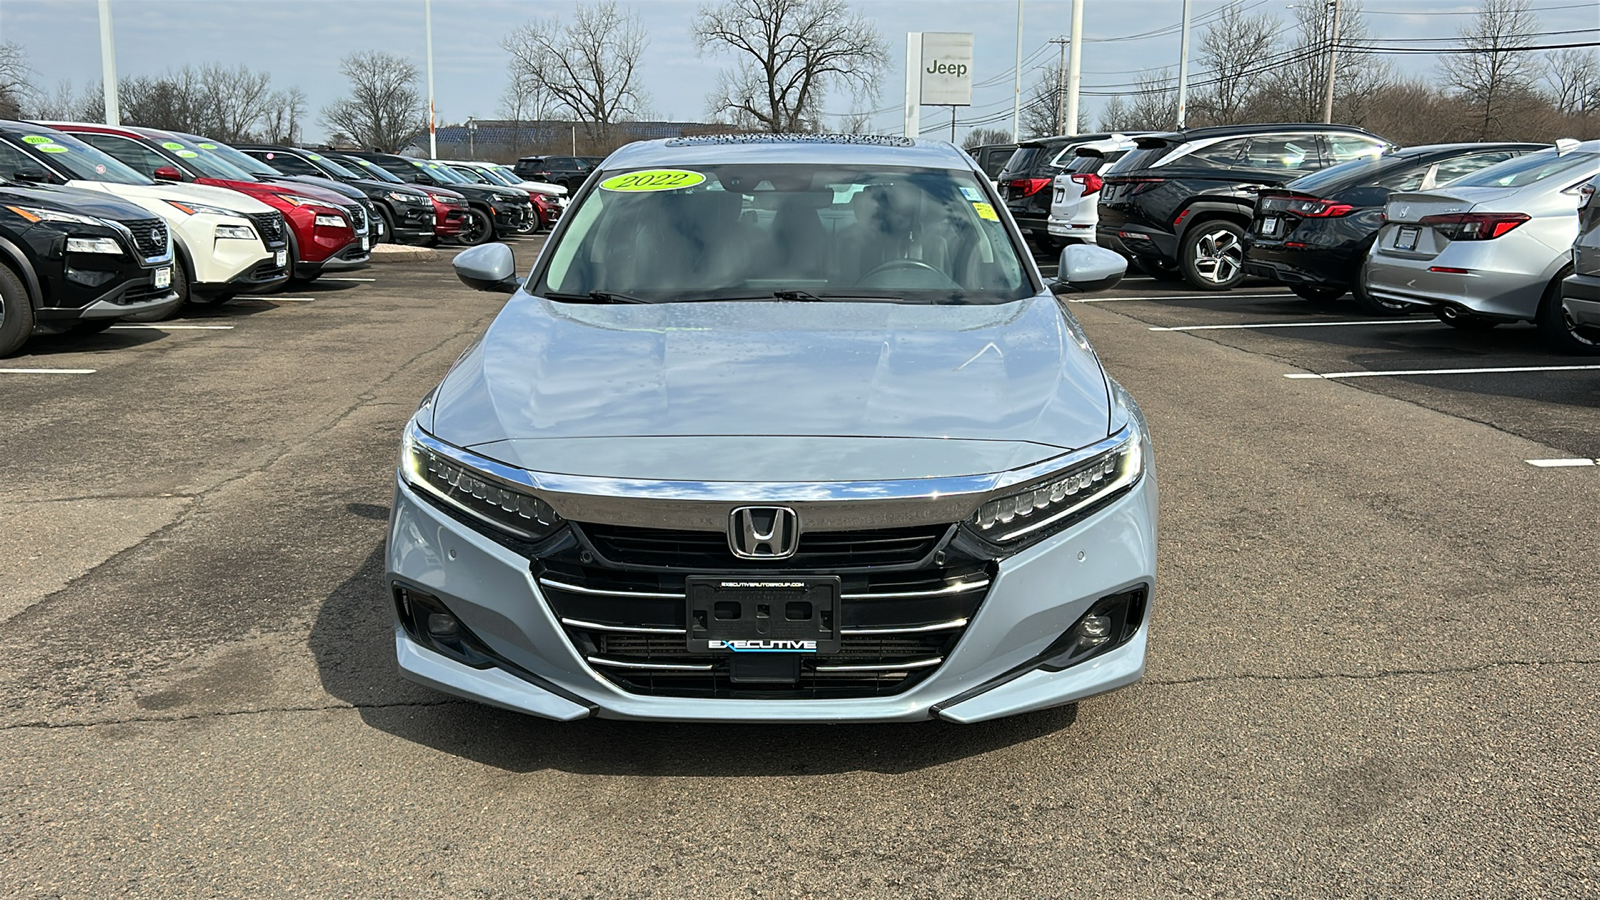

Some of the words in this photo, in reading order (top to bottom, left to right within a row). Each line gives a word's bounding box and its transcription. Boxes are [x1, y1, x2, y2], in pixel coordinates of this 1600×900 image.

[926, 60, 967, 78] Jeep
[615, 173, 689, 189] 2022
[708, 640, 817, 651] EXECUTIVE
